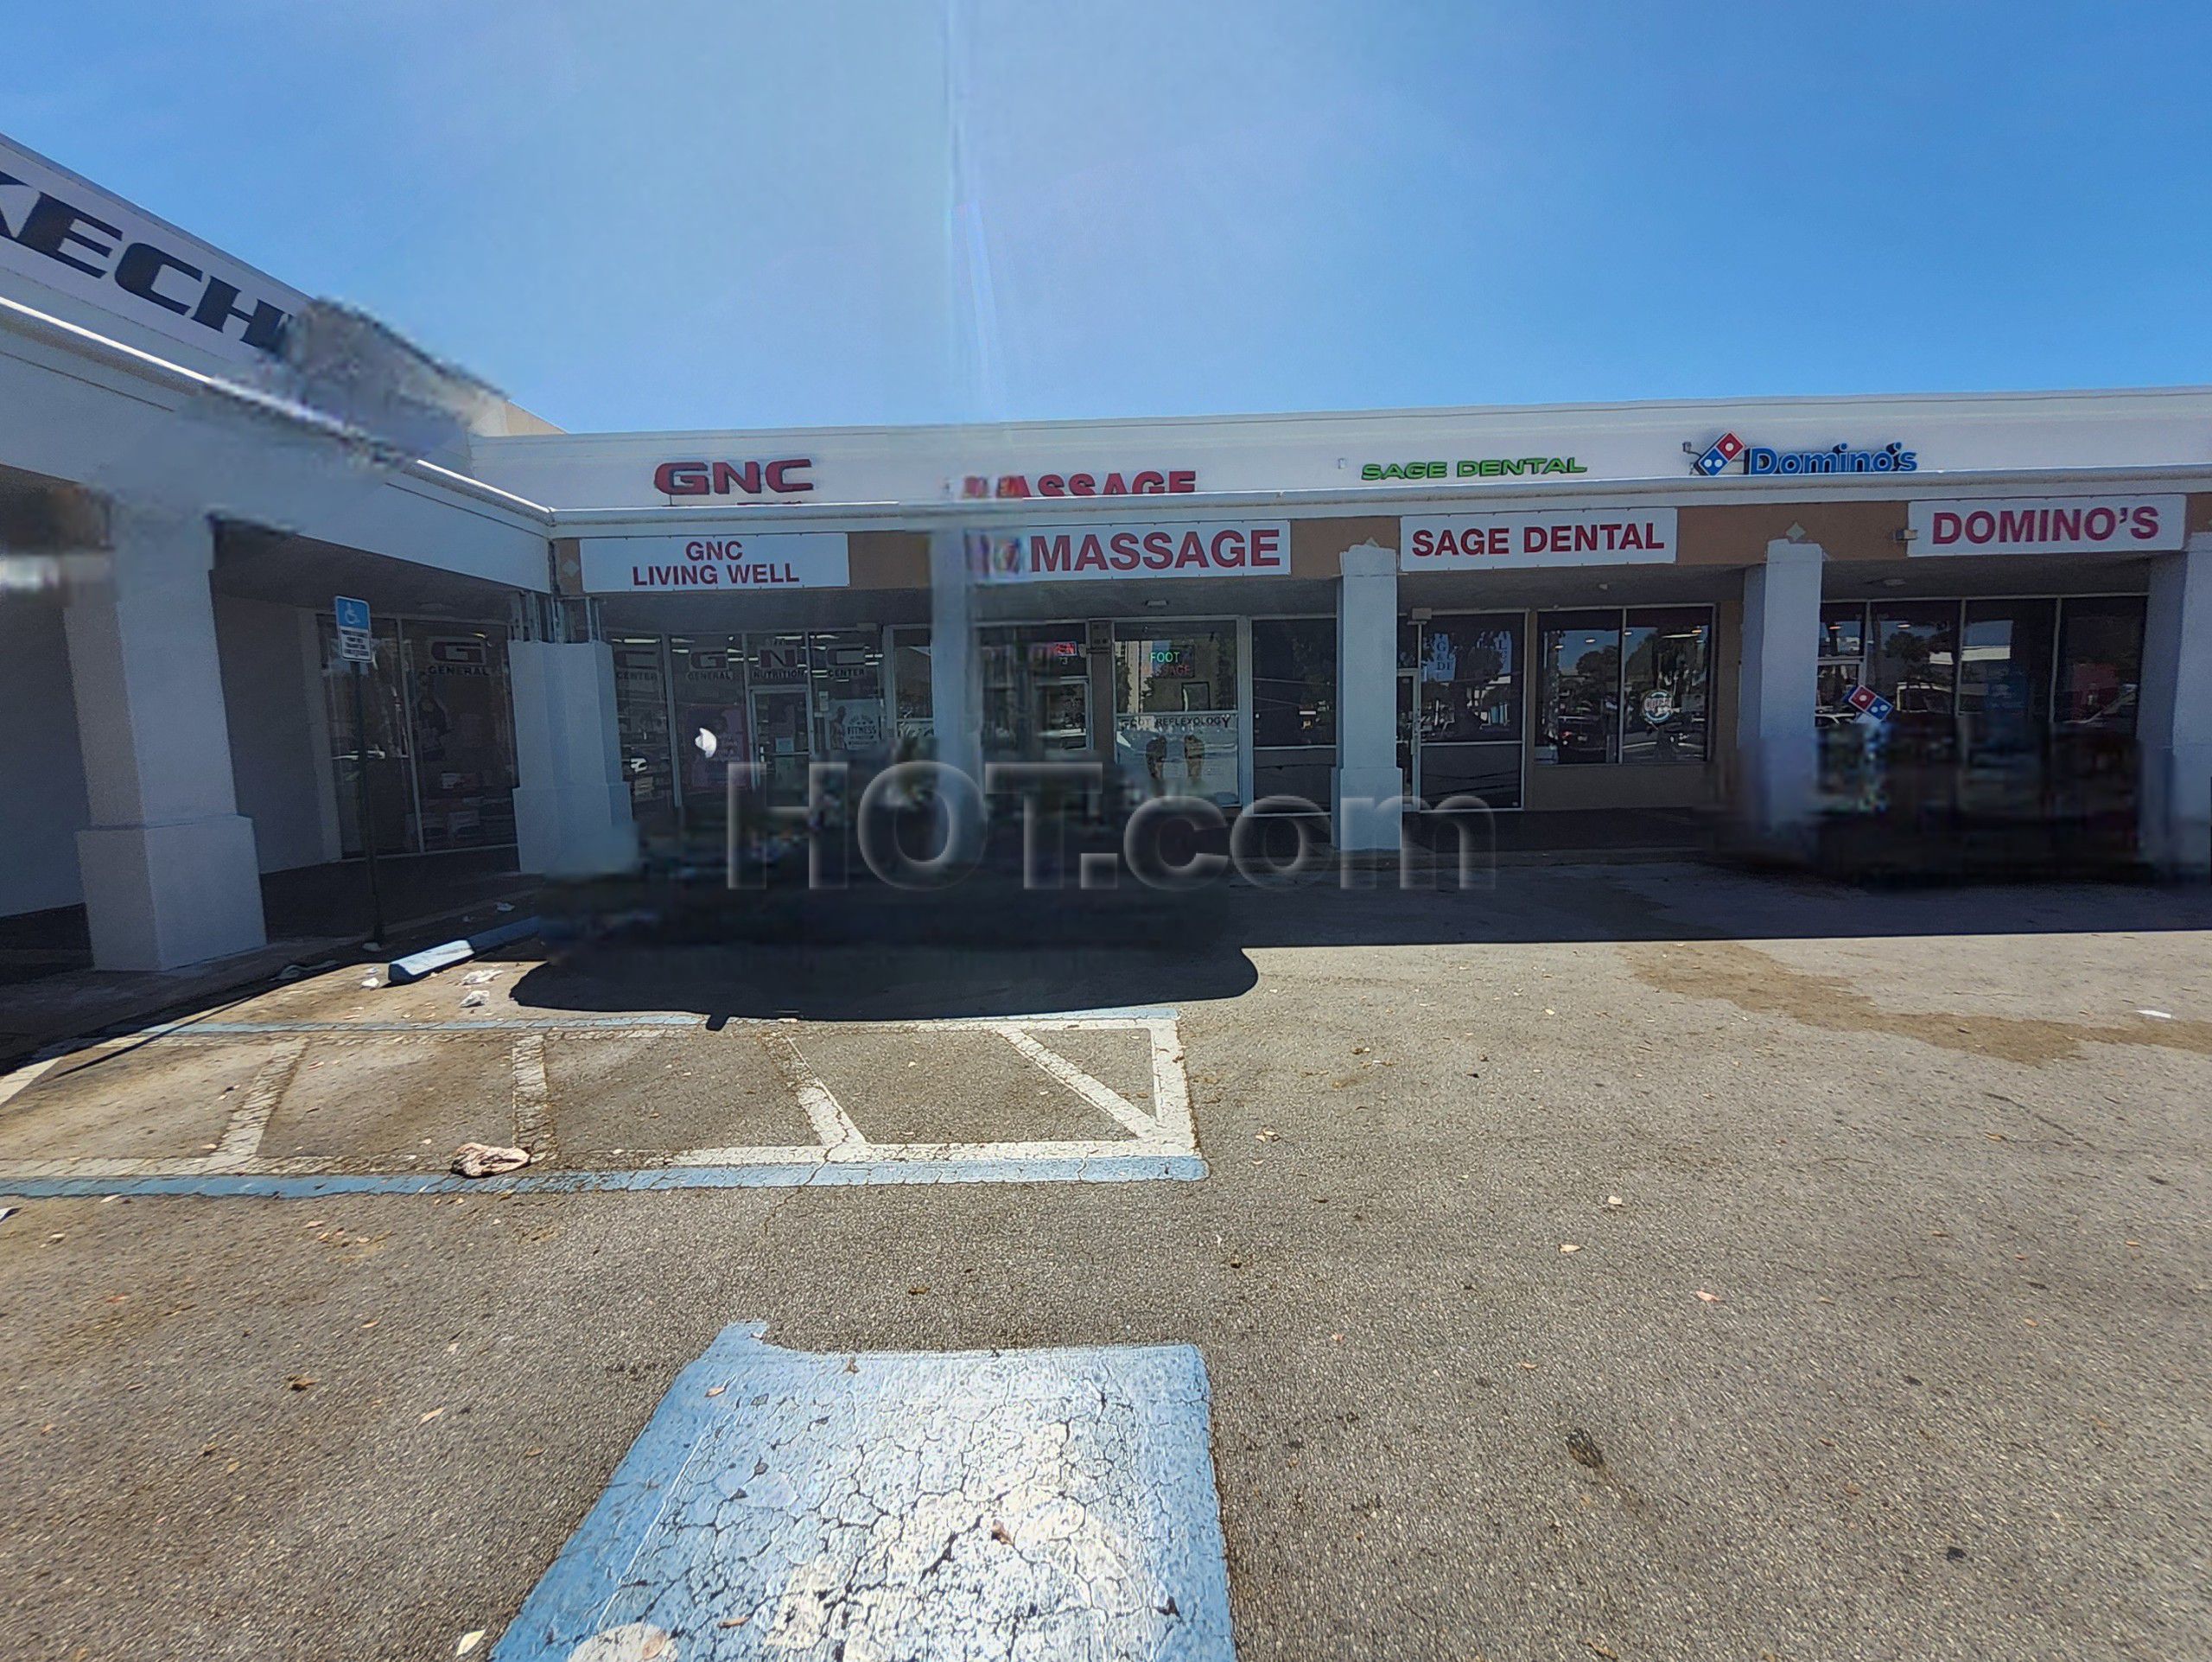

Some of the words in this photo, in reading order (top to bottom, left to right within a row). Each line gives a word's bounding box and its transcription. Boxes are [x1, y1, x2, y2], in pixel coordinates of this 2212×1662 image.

[1362, 462, 1447, 480] SAGE
[1457, 457, 1588, 478] DENTAL
[1745, 442, 1917, 474] Domino's
[654, 459, 814, 495] GNC
[962, 470, 1197, 499] ASSAGE
[1932, 506, 2159, 544] DOMINO'S
[685, 541, 743, 561] GNC
[1030, 529, 1281, 572] MASSAGE
[1412, 528, 1510, 557] SAGE
[1523, 522, 1665, 553] DENTAL
[632, 564, 718, 586] LIVING
[727, 563, 799, 584] WELL
[1150, 651, 1180, 664] FOOT
[429, 665, 490, 677] GENERAL
[828, 668, 865, 678] CENTER
[1155, 716, 1230, 728] REFLEXOLOGY
